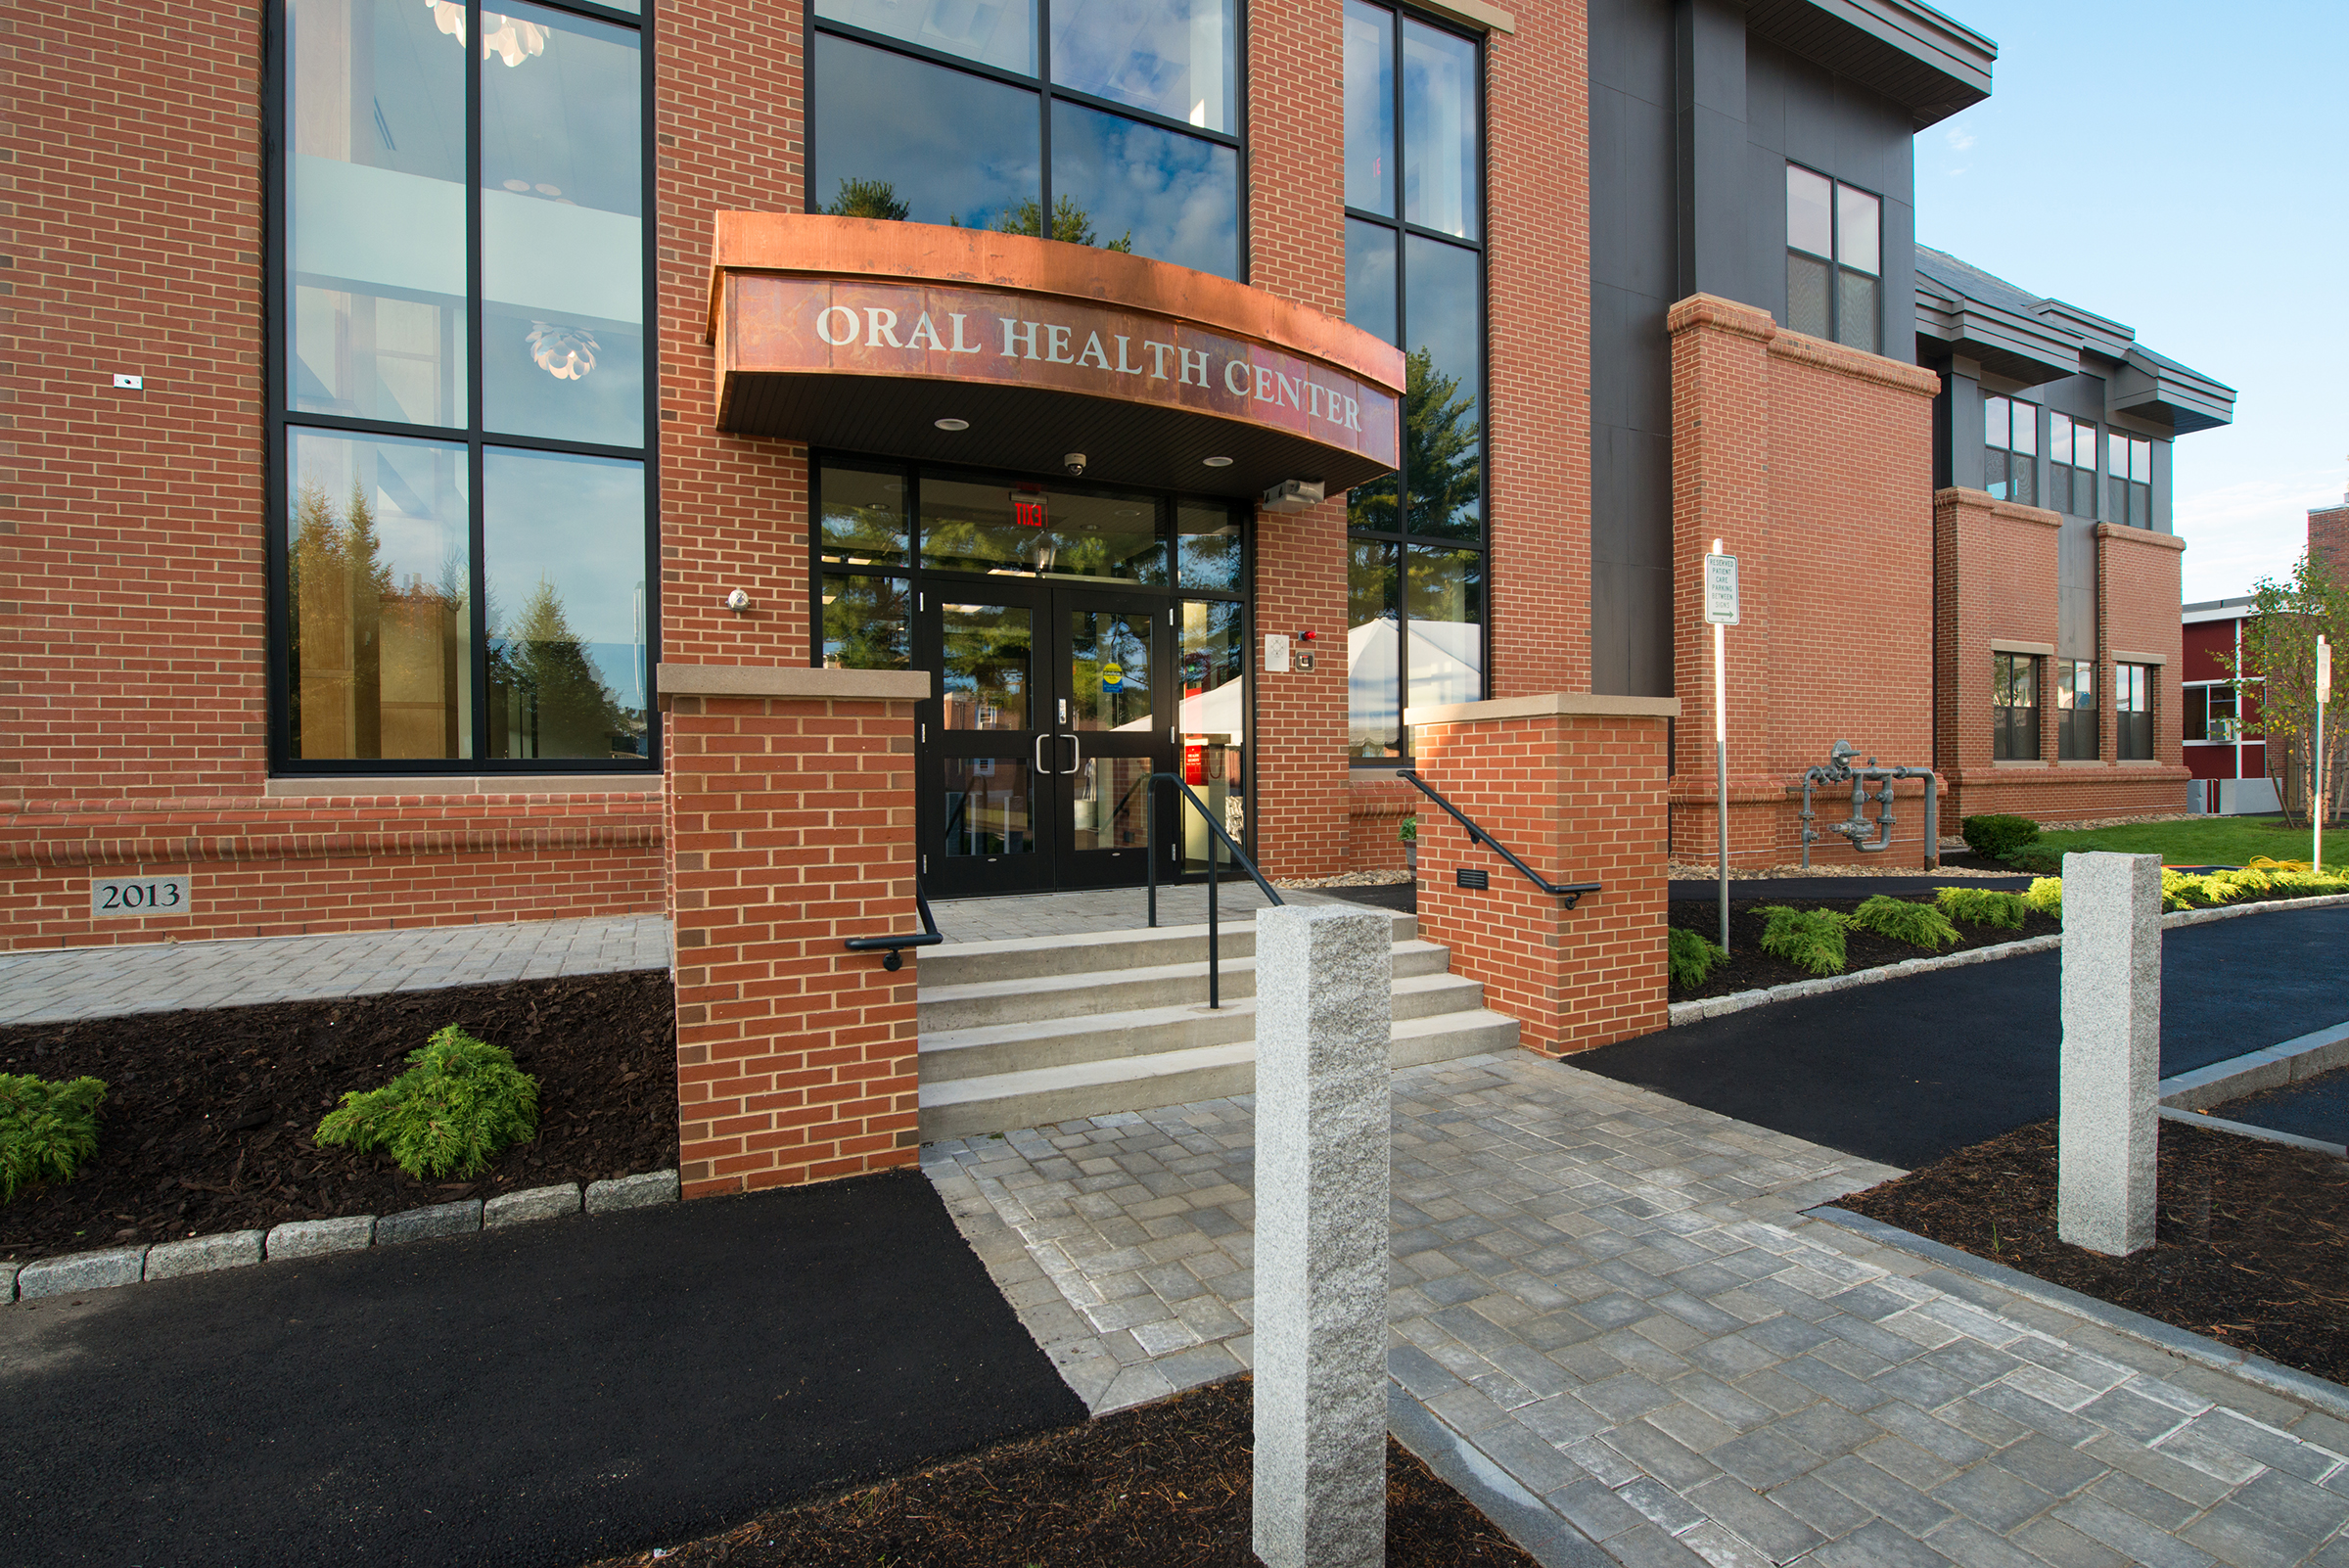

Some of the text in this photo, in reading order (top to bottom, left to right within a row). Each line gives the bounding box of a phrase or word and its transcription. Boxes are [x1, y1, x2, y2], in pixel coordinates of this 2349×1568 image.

[816, 305, 1362, 433] ORAL HEALTH CENTER
[102, 883, 181, 909] 2013
